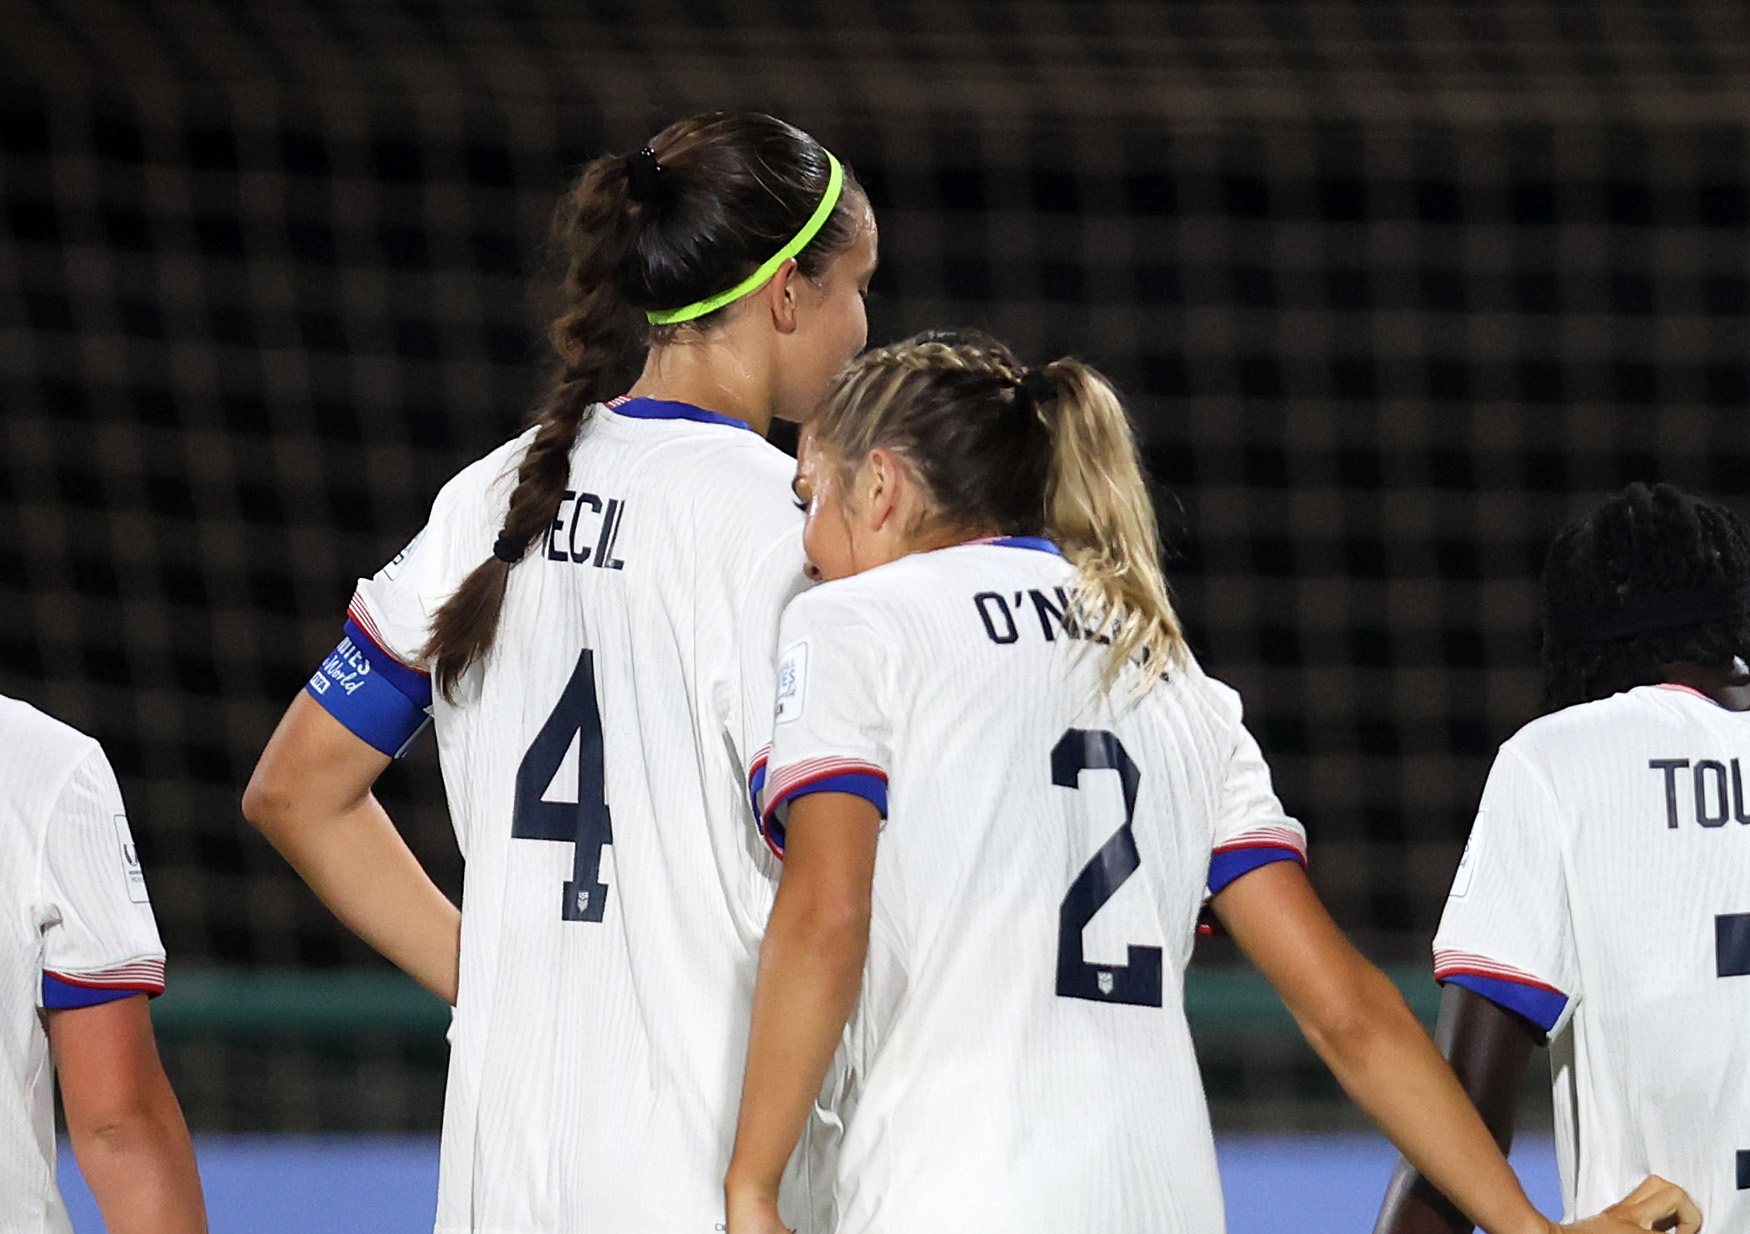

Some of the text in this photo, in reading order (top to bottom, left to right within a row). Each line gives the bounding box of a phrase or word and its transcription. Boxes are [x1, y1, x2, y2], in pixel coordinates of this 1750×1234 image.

[541, 489, 626, 571] ECIL
[510, 648, 612, 924] 4
[1050, 727, 1163, 1008] 2
